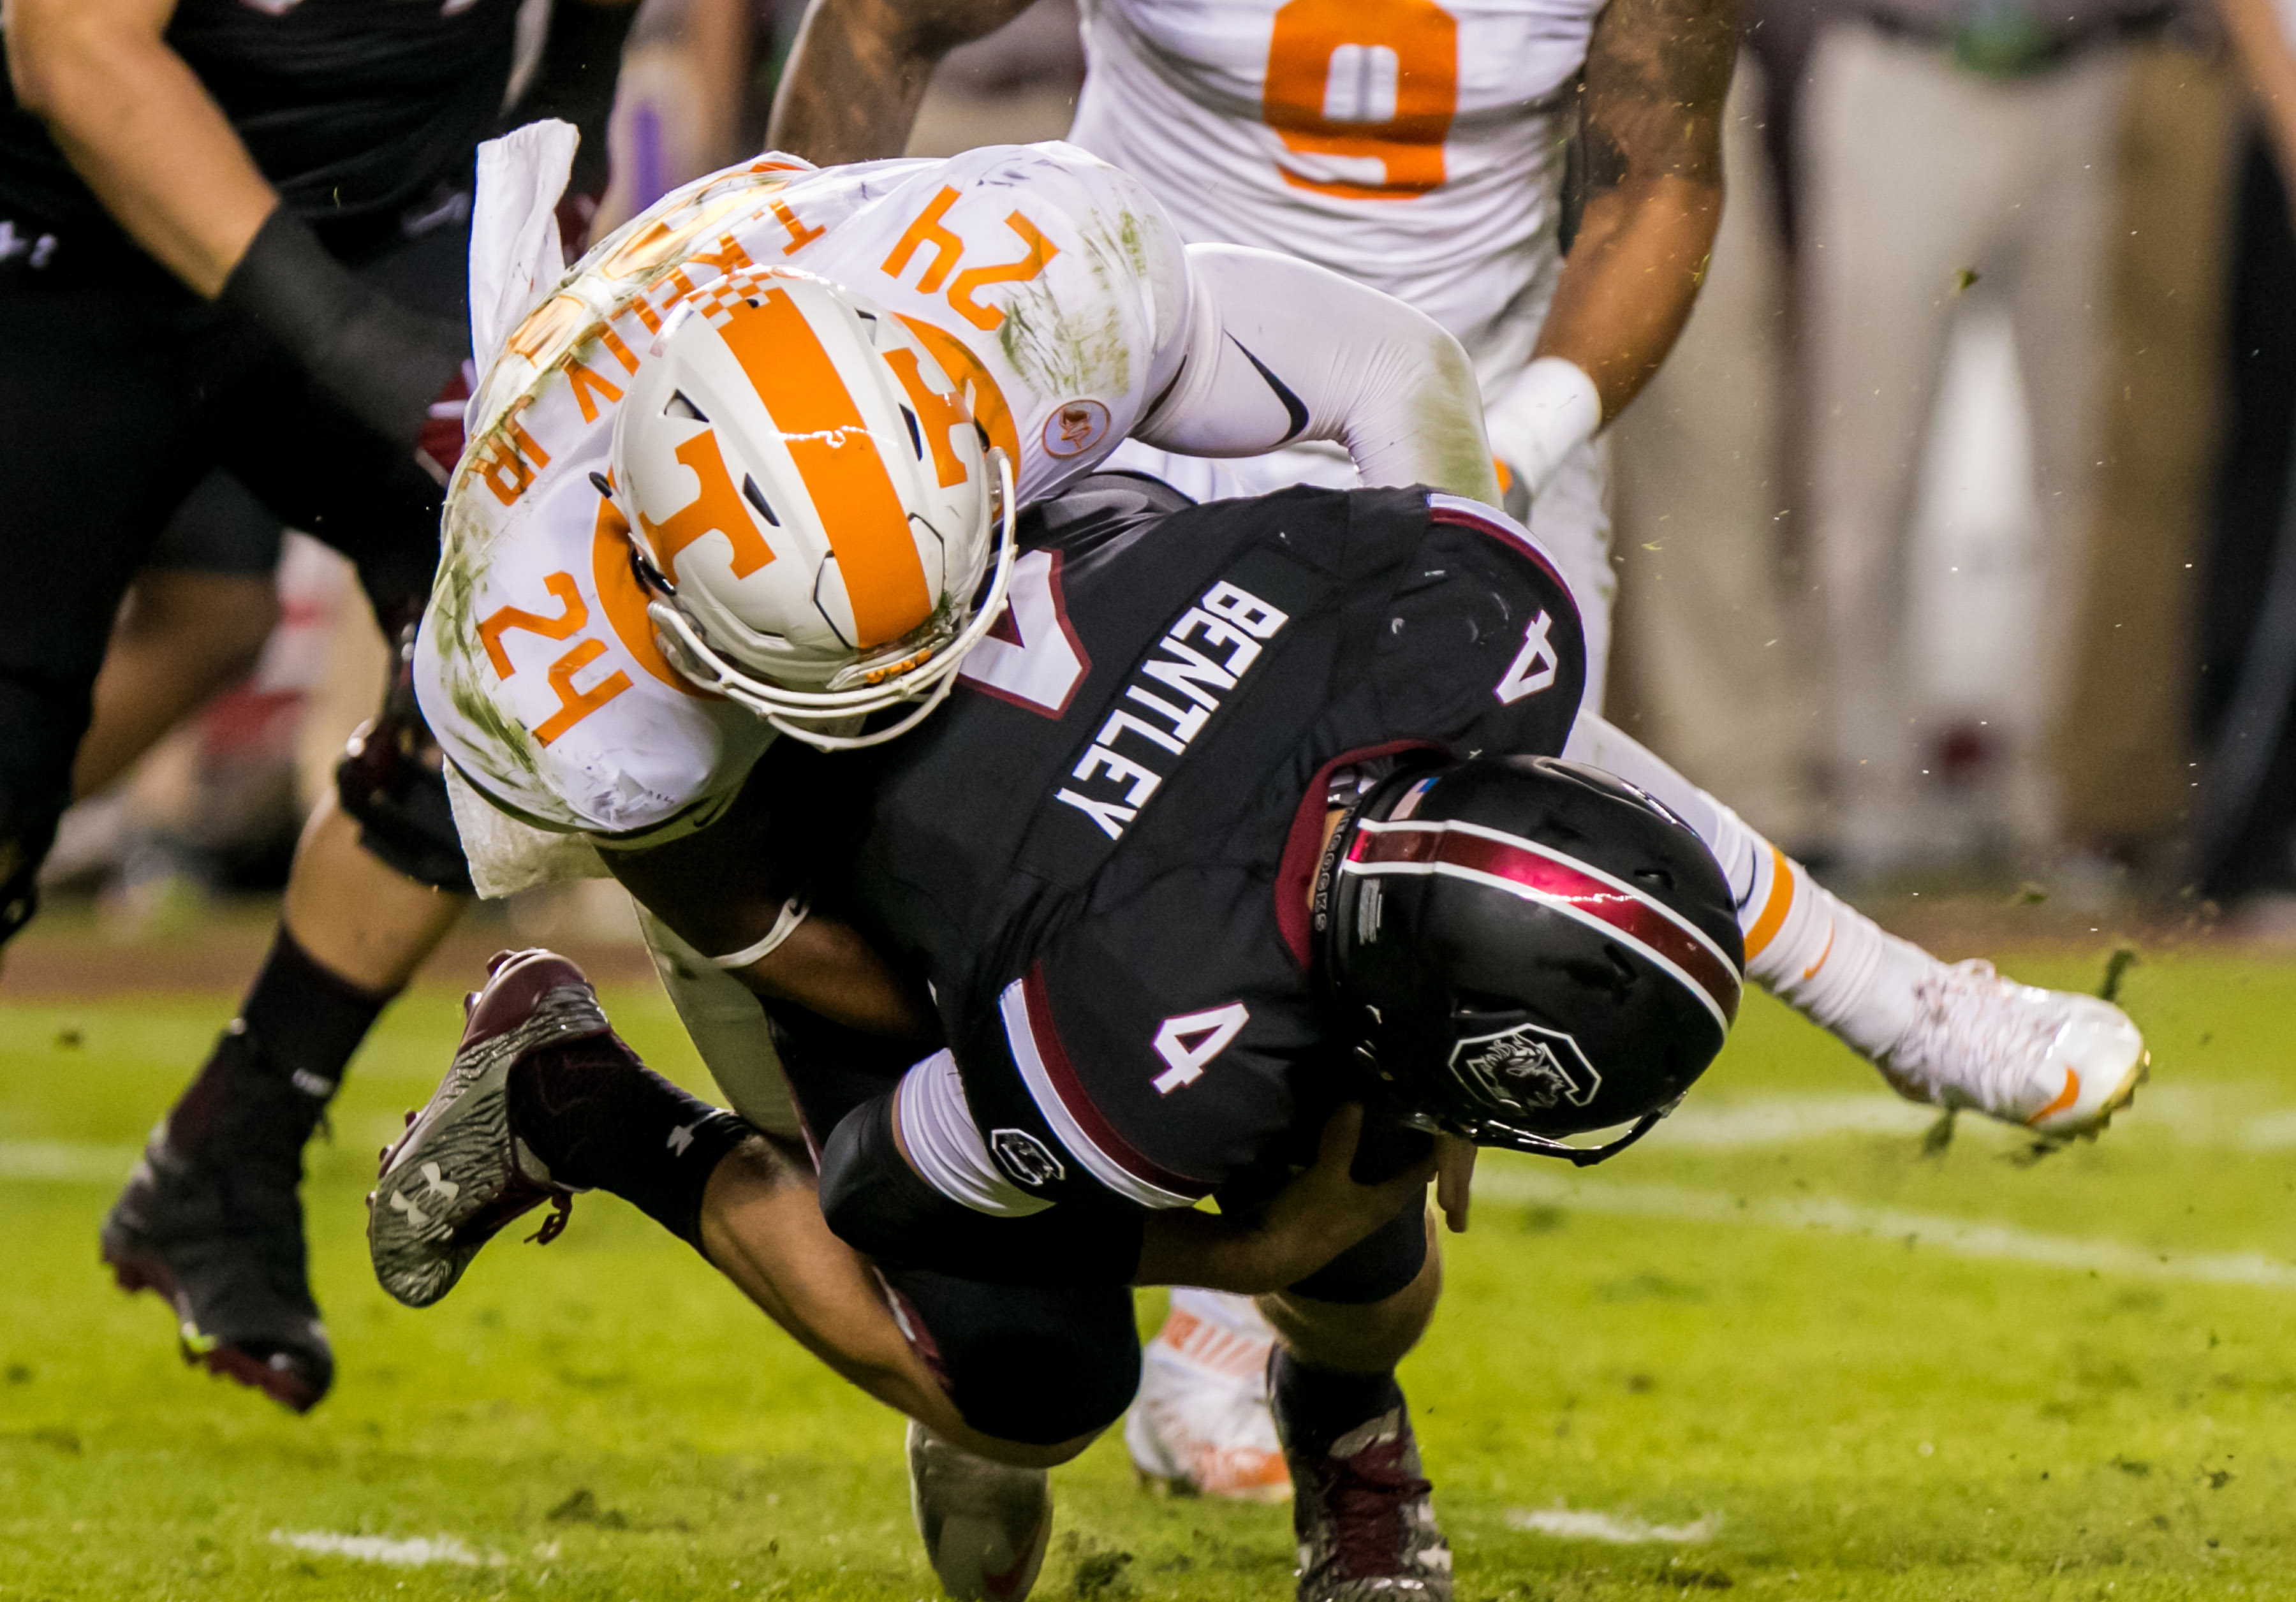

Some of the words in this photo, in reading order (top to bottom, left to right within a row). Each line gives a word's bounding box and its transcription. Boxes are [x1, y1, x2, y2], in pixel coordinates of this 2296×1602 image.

[1262, 0, 1459, 200] 9
[880, 186, 1059, 331] 24
[639, 428, 777, 585] T
[475, 571, 633, 749] 24
[1054, 580, 1290, 841] BENTLEY
[1494, 610, 1559, 705] 4
[1151, 1001, 1250, 1096] 4
